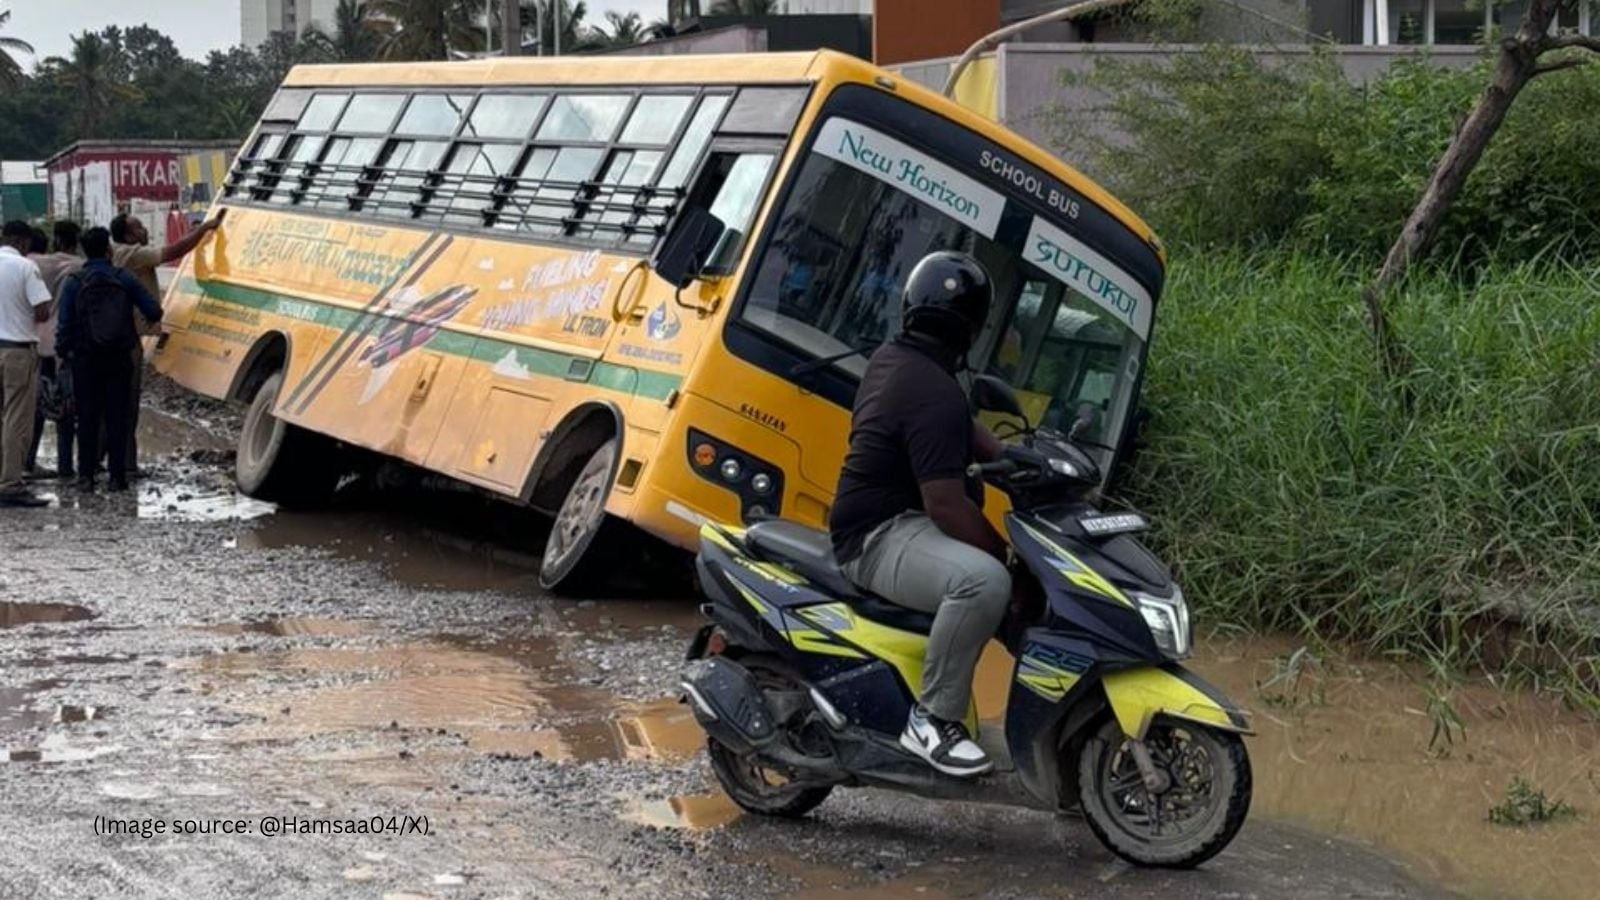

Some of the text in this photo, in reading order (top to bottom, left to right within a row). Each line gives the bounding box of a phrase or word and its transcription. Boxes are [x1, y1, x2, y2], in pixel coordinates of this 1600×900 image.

[112, 159, 180, 187] IFTKAR
[838, 129, 982, 221] New Horizon
[979, 150, 1081, 220] SCHOOL BUS
